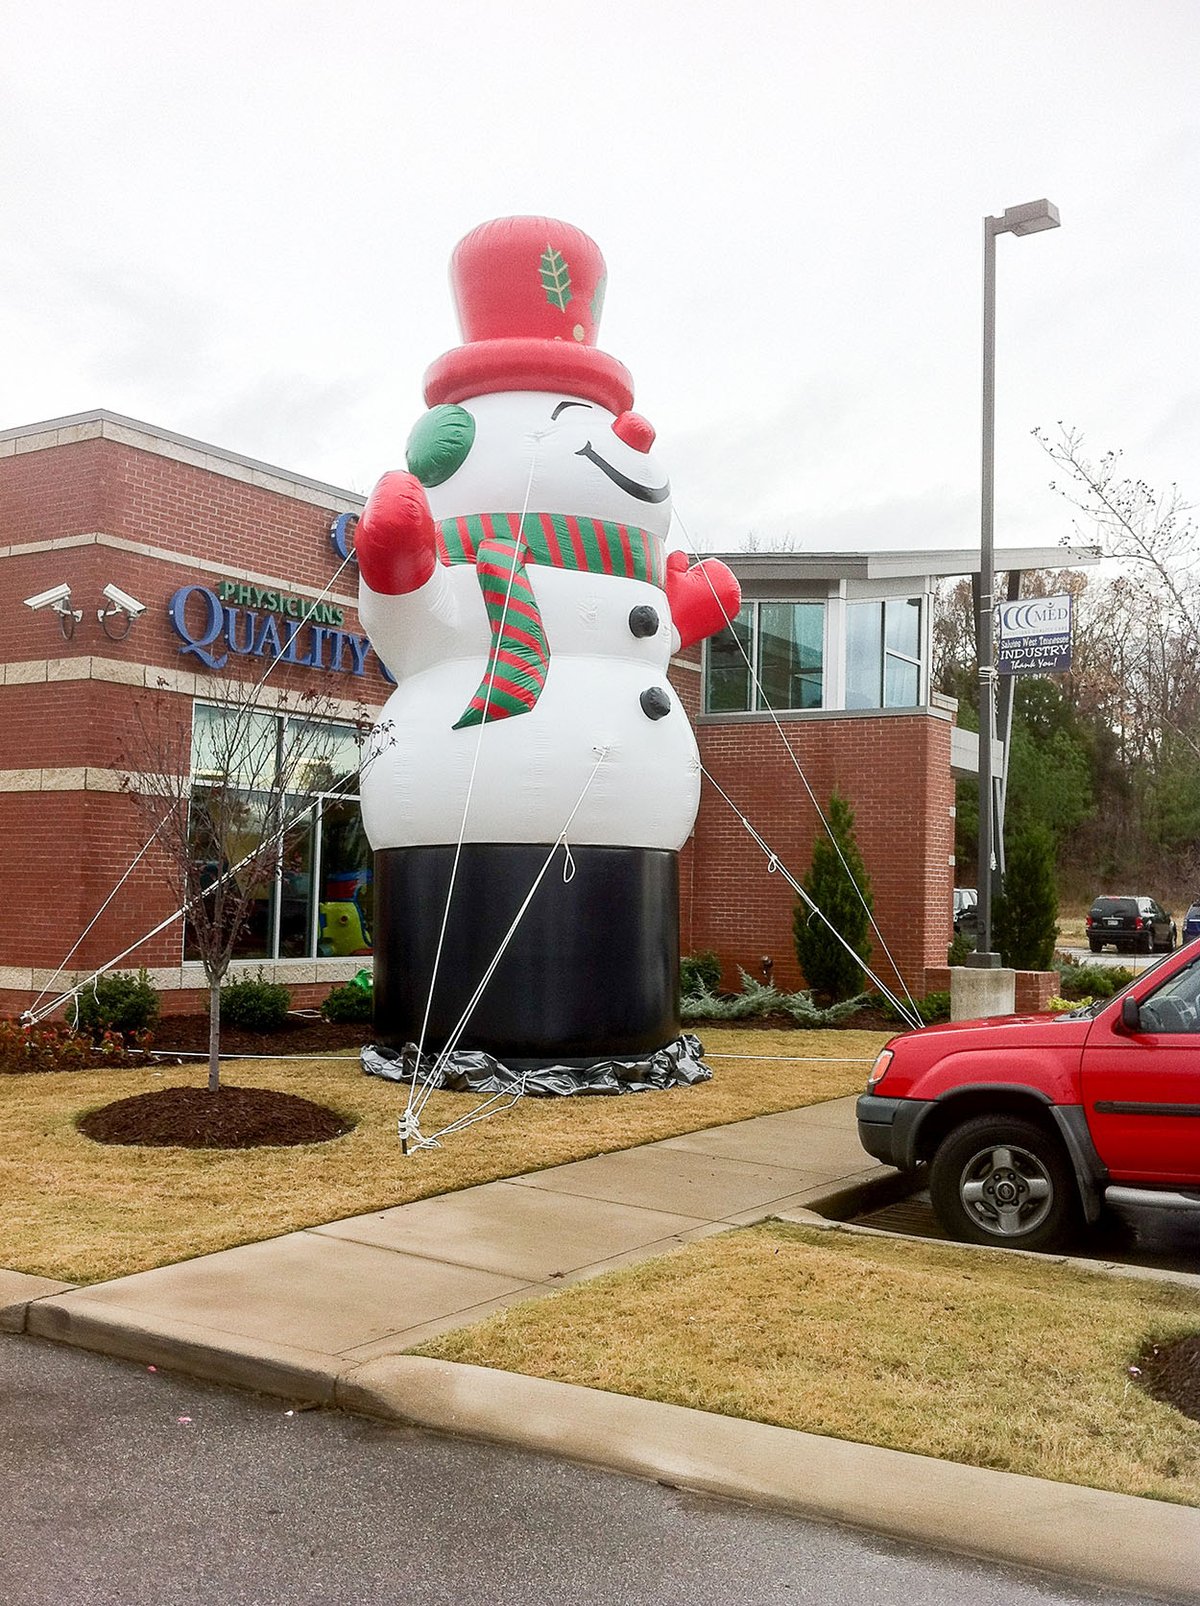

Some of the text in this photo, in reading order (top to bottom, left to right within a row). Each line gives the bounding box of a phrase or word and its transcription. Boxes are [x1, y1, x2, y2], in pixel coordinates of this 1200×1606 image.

[219, 580, 345, 626] PHYSICIANS
[168, 584, 371, 676] QUALITY
[1023, 637, 1038, 647] West
[1000, 644, 1069, 660] INDUSTRY
[1011, 657, 1058, 670] Thank You!
